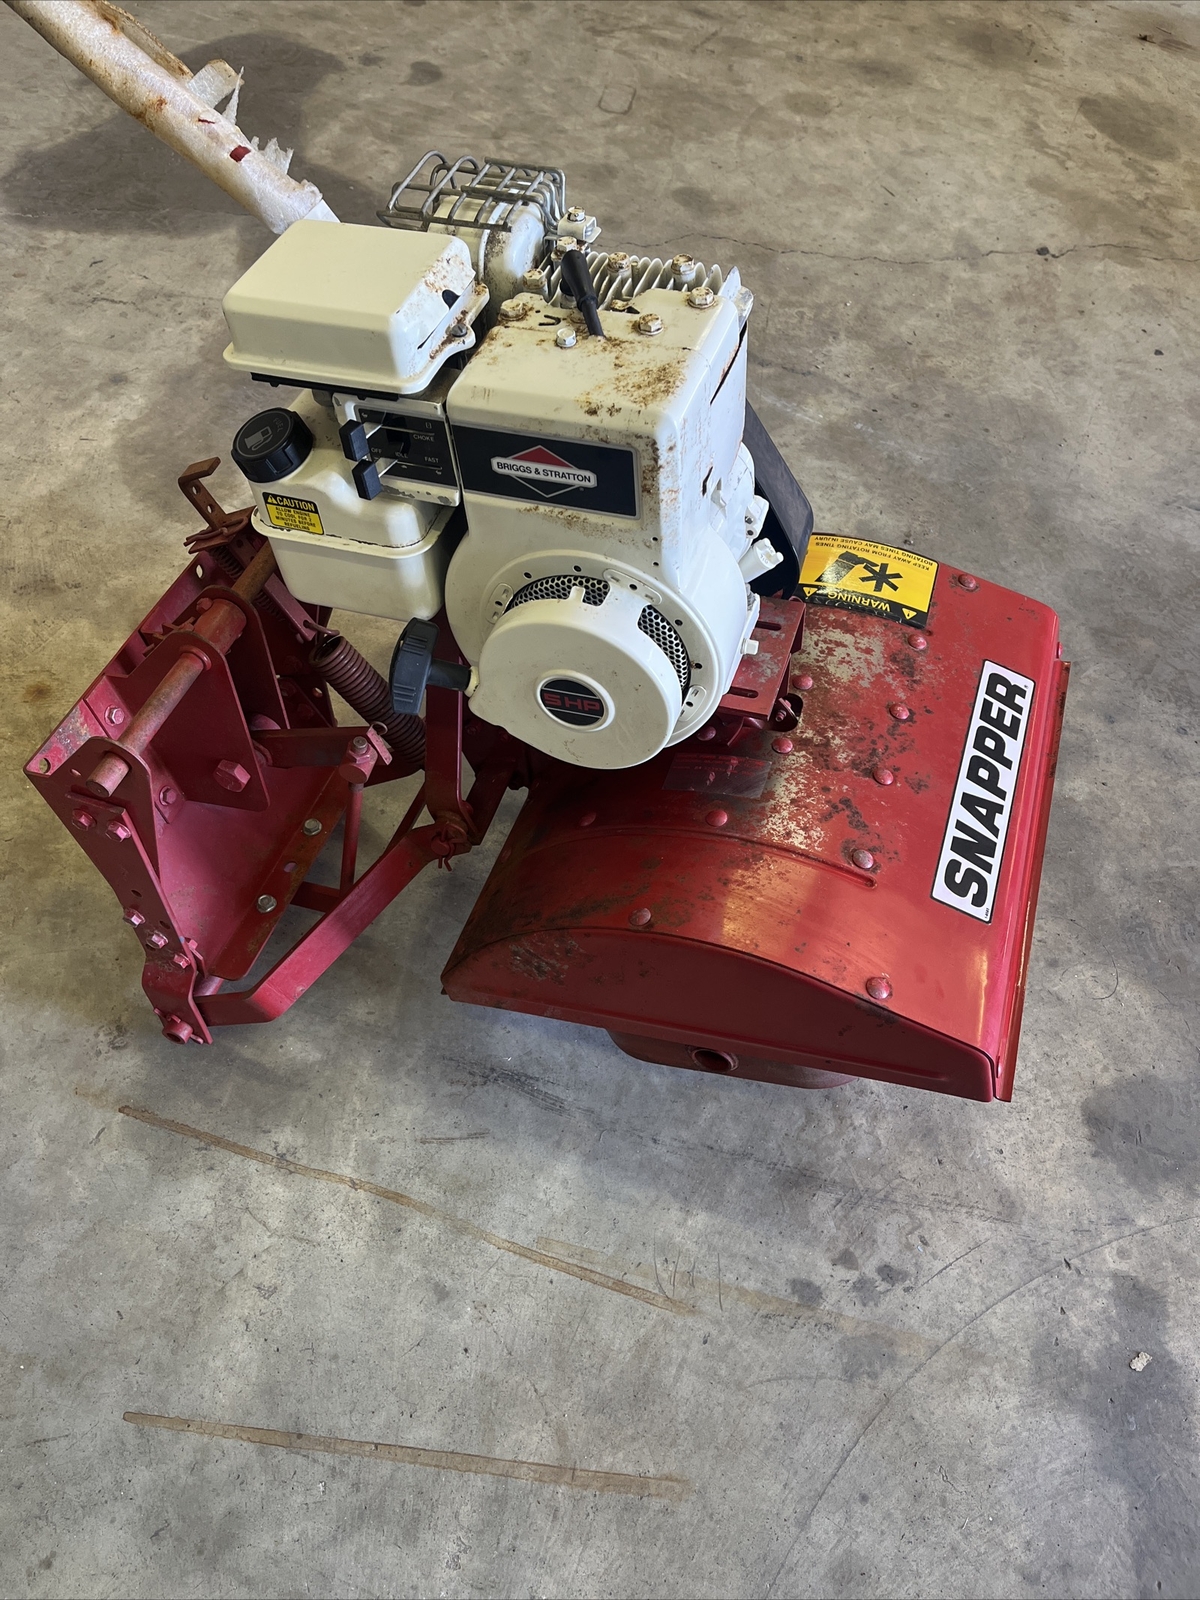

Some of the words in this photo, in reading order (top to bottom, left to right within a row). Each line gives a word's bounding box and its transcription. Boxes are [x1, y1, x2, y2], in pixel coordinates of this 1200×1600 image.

[413, 433, 435, 442] CHOKE
[394, 451, 408, 459] IDLE
[496, 461, 532, 474] BRIGGS
[534, 468, 541, 476] &
[542, 469, 591, 483] STRATTON
[276, 497, 315, 511] CAUTION
[284, 522, 310, 530] REFUELING
[298, 520, 316, 528] BEFORE
[840, 538, 863, 546] CAUSE
[863, 541, 879, 550] MAY
[836, 543, 870, 554] ROTATING
[880, 545, 899, 555] TINES
[871, 550, 891, 560] FROM
[901, 551, 933, 566] ROTATING
[892, 556, 911, 566] AWAY
[912, 562, 930, 571] KEEP
[827, 591, 891, 612] WARNING
[564, 696, 600, 711] HP
[944, 672, 1027, 908] SNAPPER
